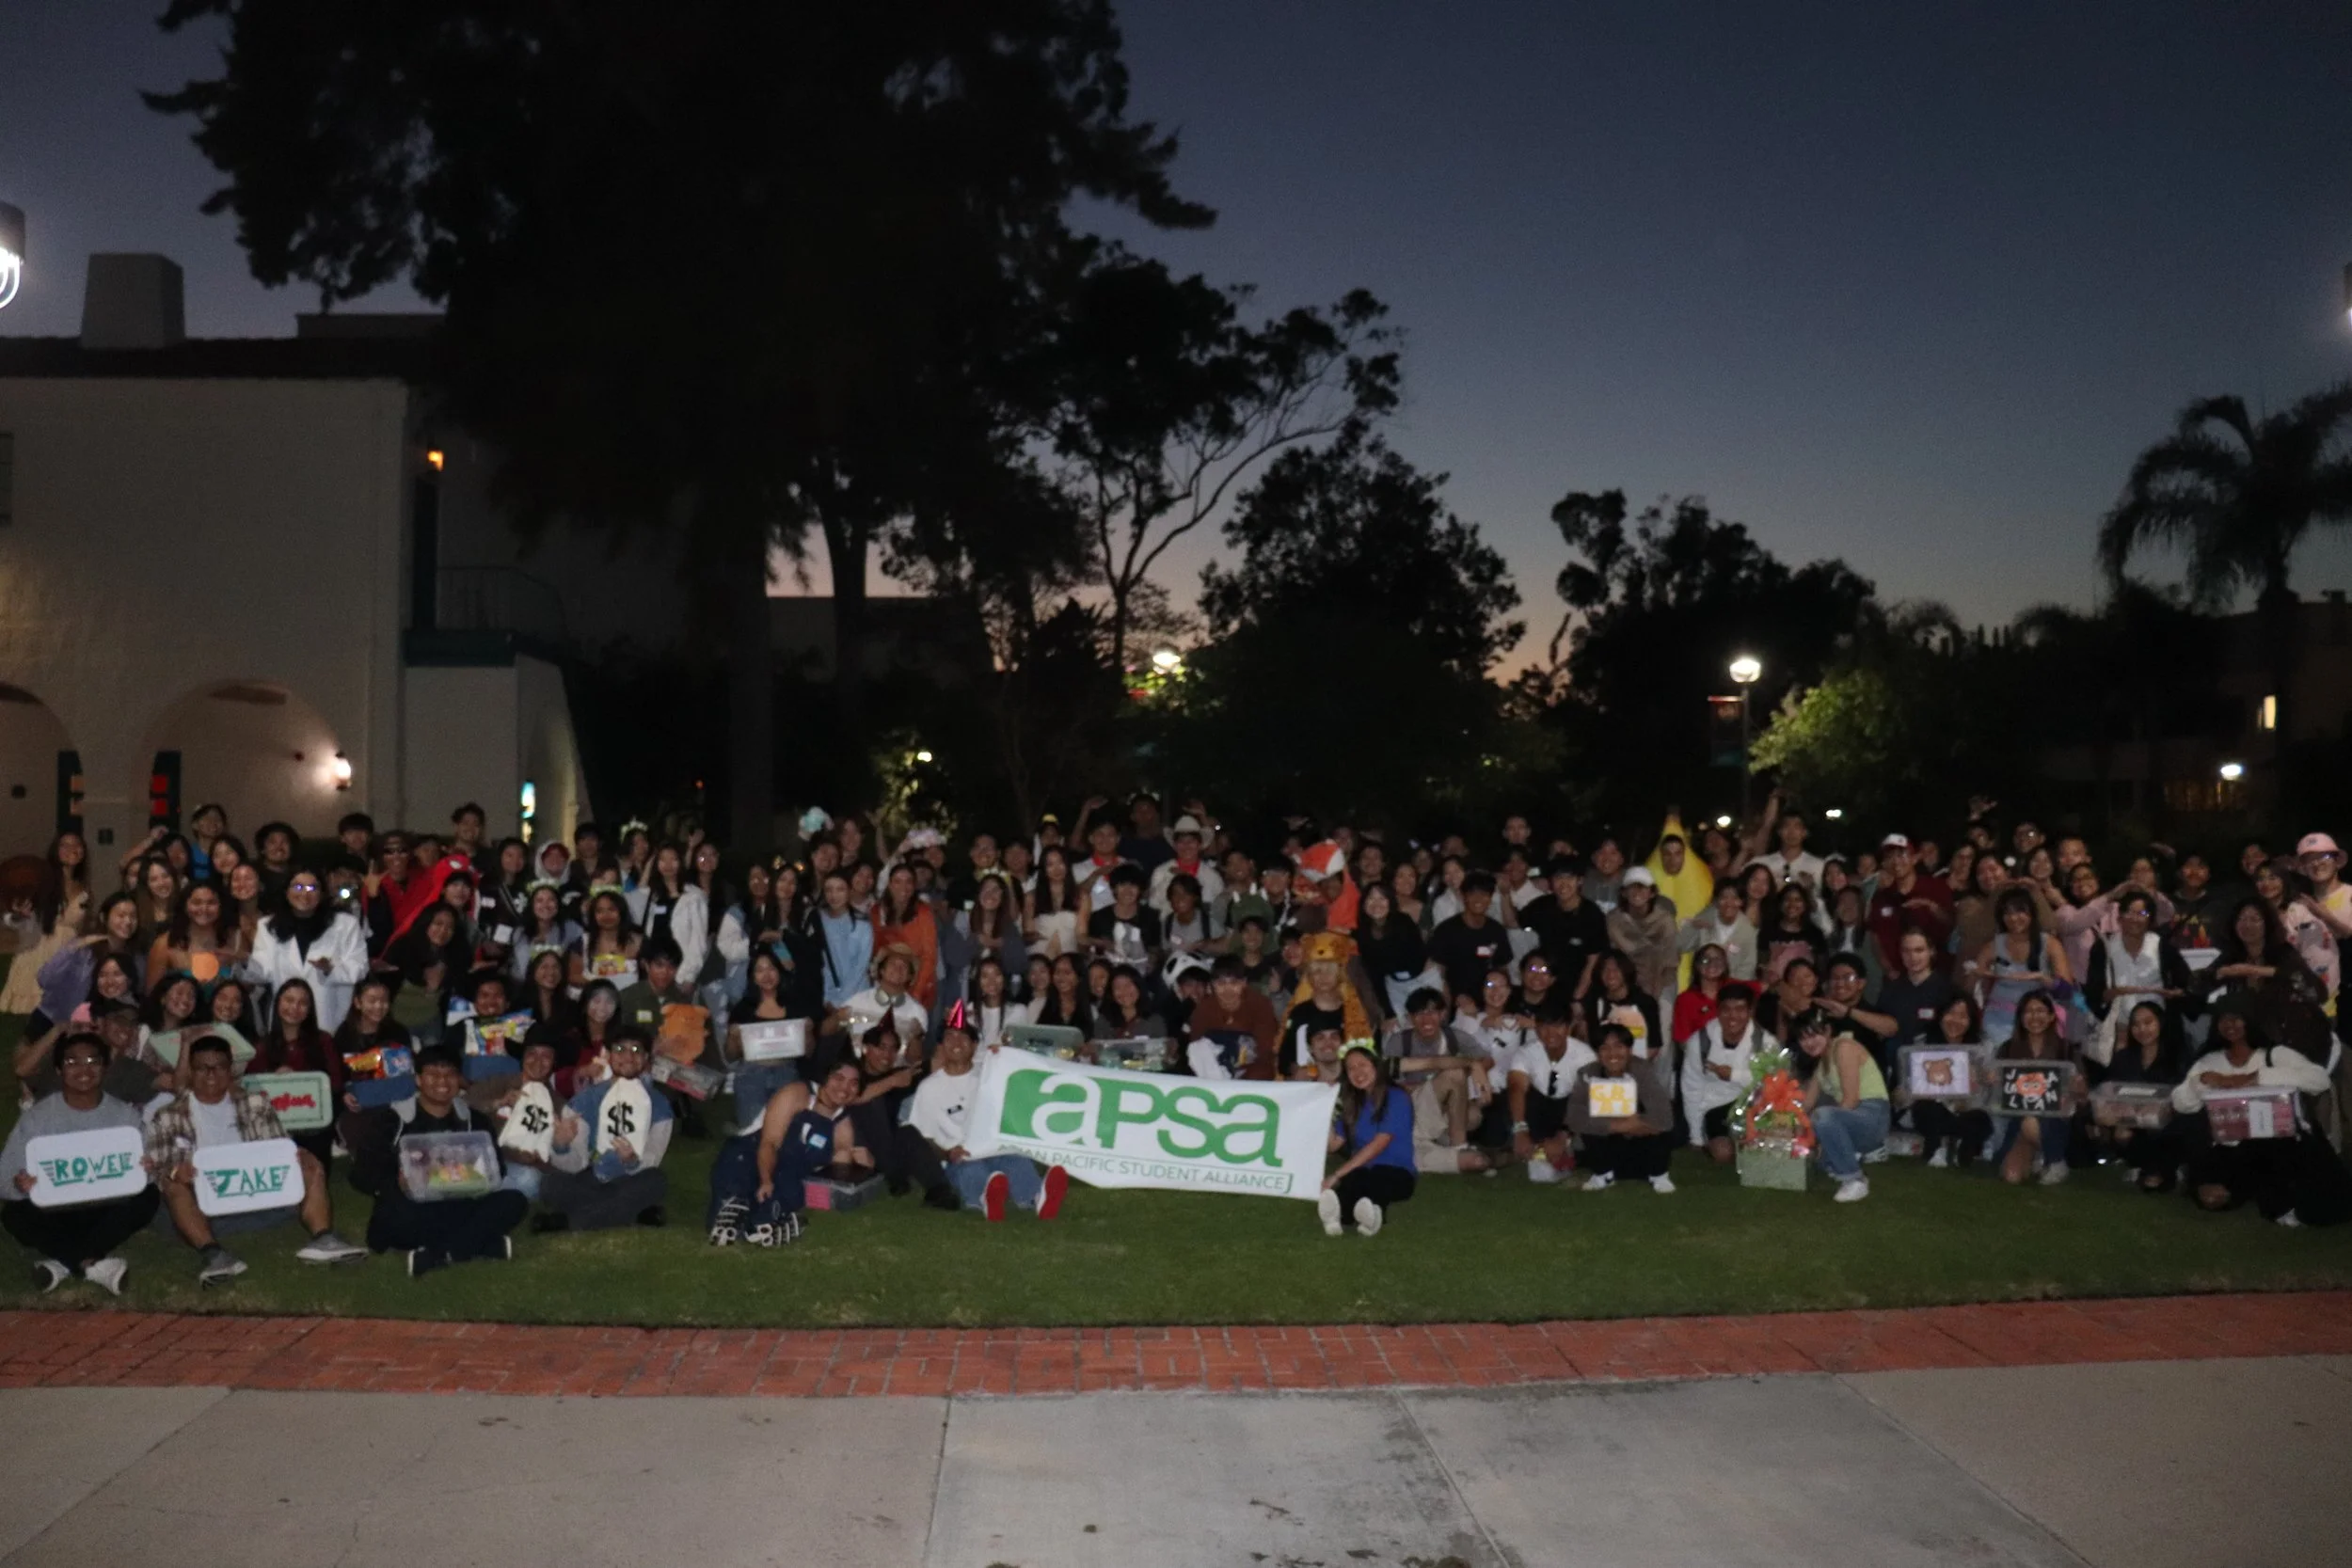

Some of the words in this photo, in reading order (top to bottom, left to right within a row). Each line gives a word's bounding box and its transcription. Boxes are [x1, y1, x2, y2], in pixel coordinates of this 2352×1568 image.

[1031, 1072, 1283, 1167] apsa
[215, 1165, 290, 1195] JAKE
[1051, 1152, 1116, 1173] PACIFIC
[1119, 1160, 1200, 1180] STUDENT
[1204, 1170, 1284, 1190] ALLIANCE
